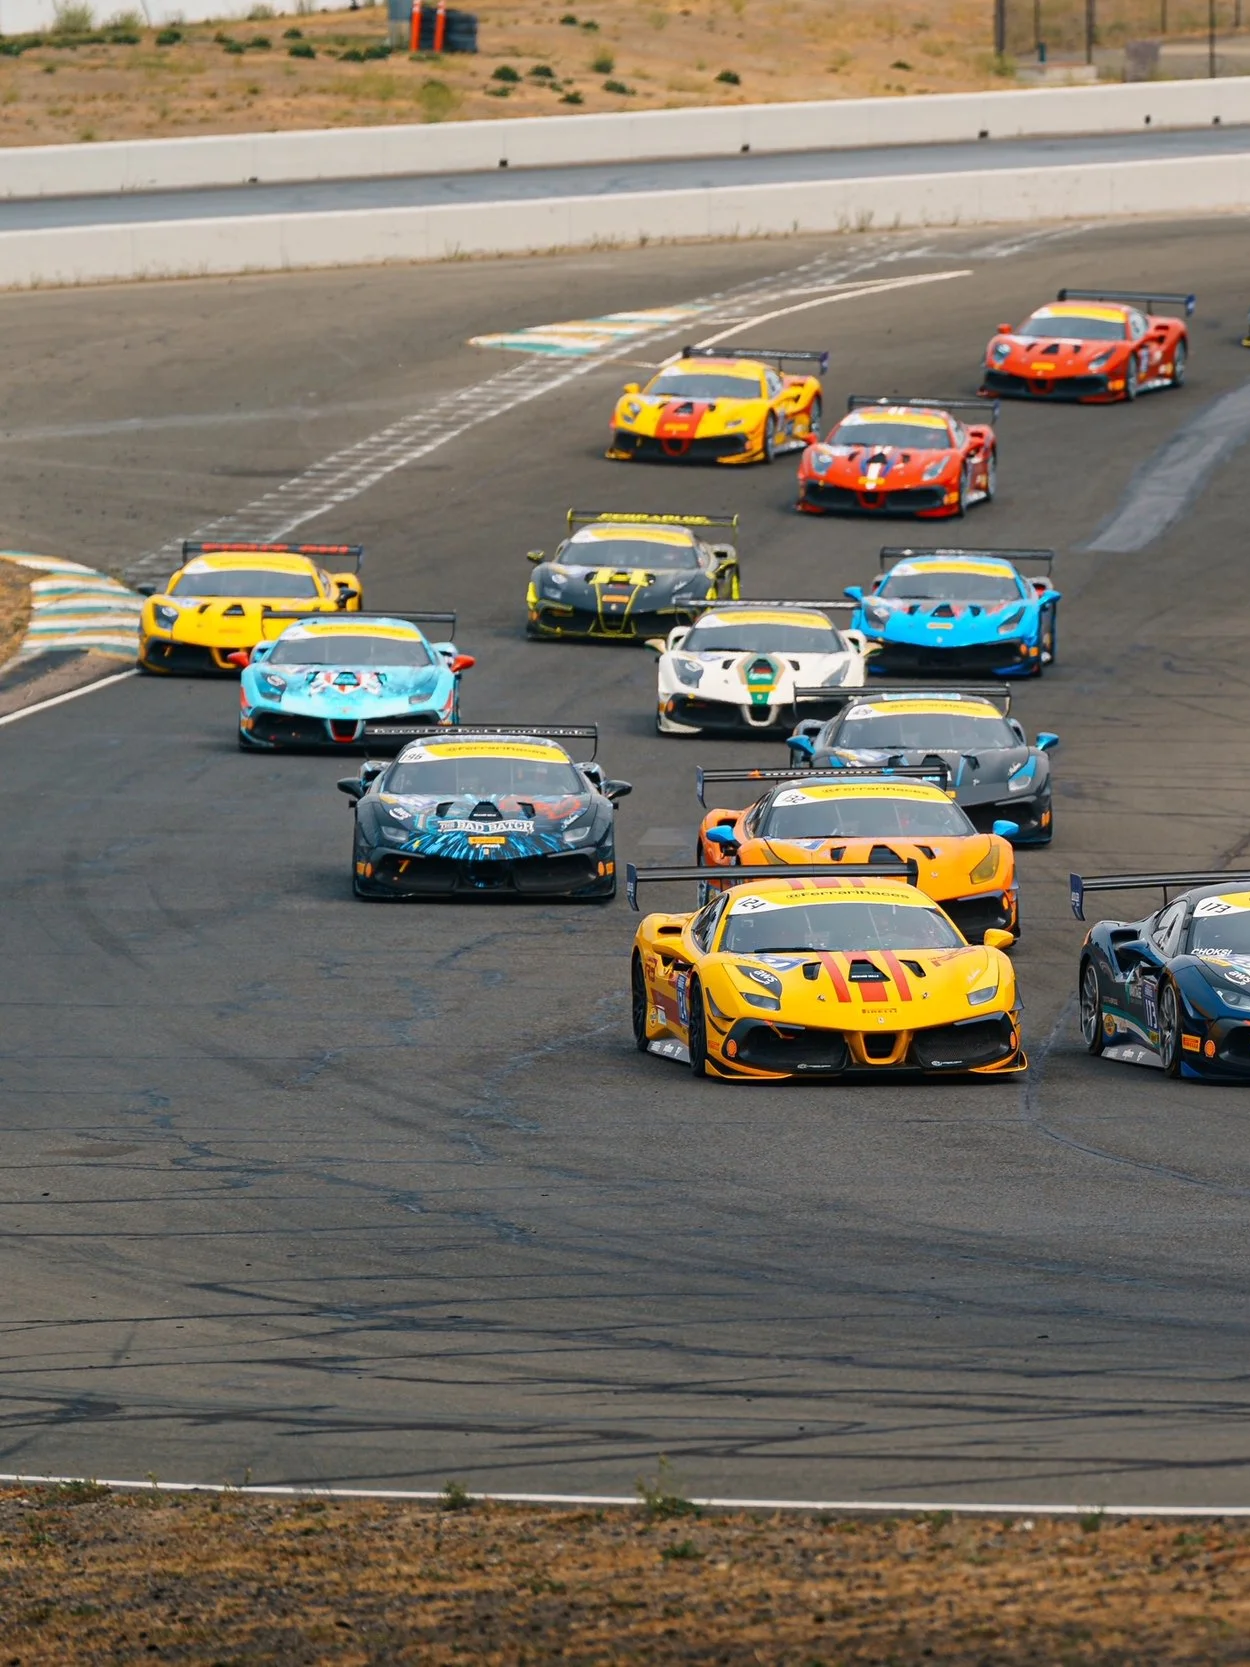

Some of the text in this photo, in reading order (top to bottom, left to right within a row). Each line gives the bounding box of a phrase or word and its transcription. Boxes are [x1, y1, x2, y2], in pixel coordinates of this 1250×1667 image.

[456, 821, 484, 832] BAD
[488, 821, 535, 834] BATCH
[785, 889, 911, 900] @FerrariRaces
[738, 897, 766, 910] 124
[1200, 901, 1232, 914] 173
[1190, 948, 1233, 956] CHOKSI
